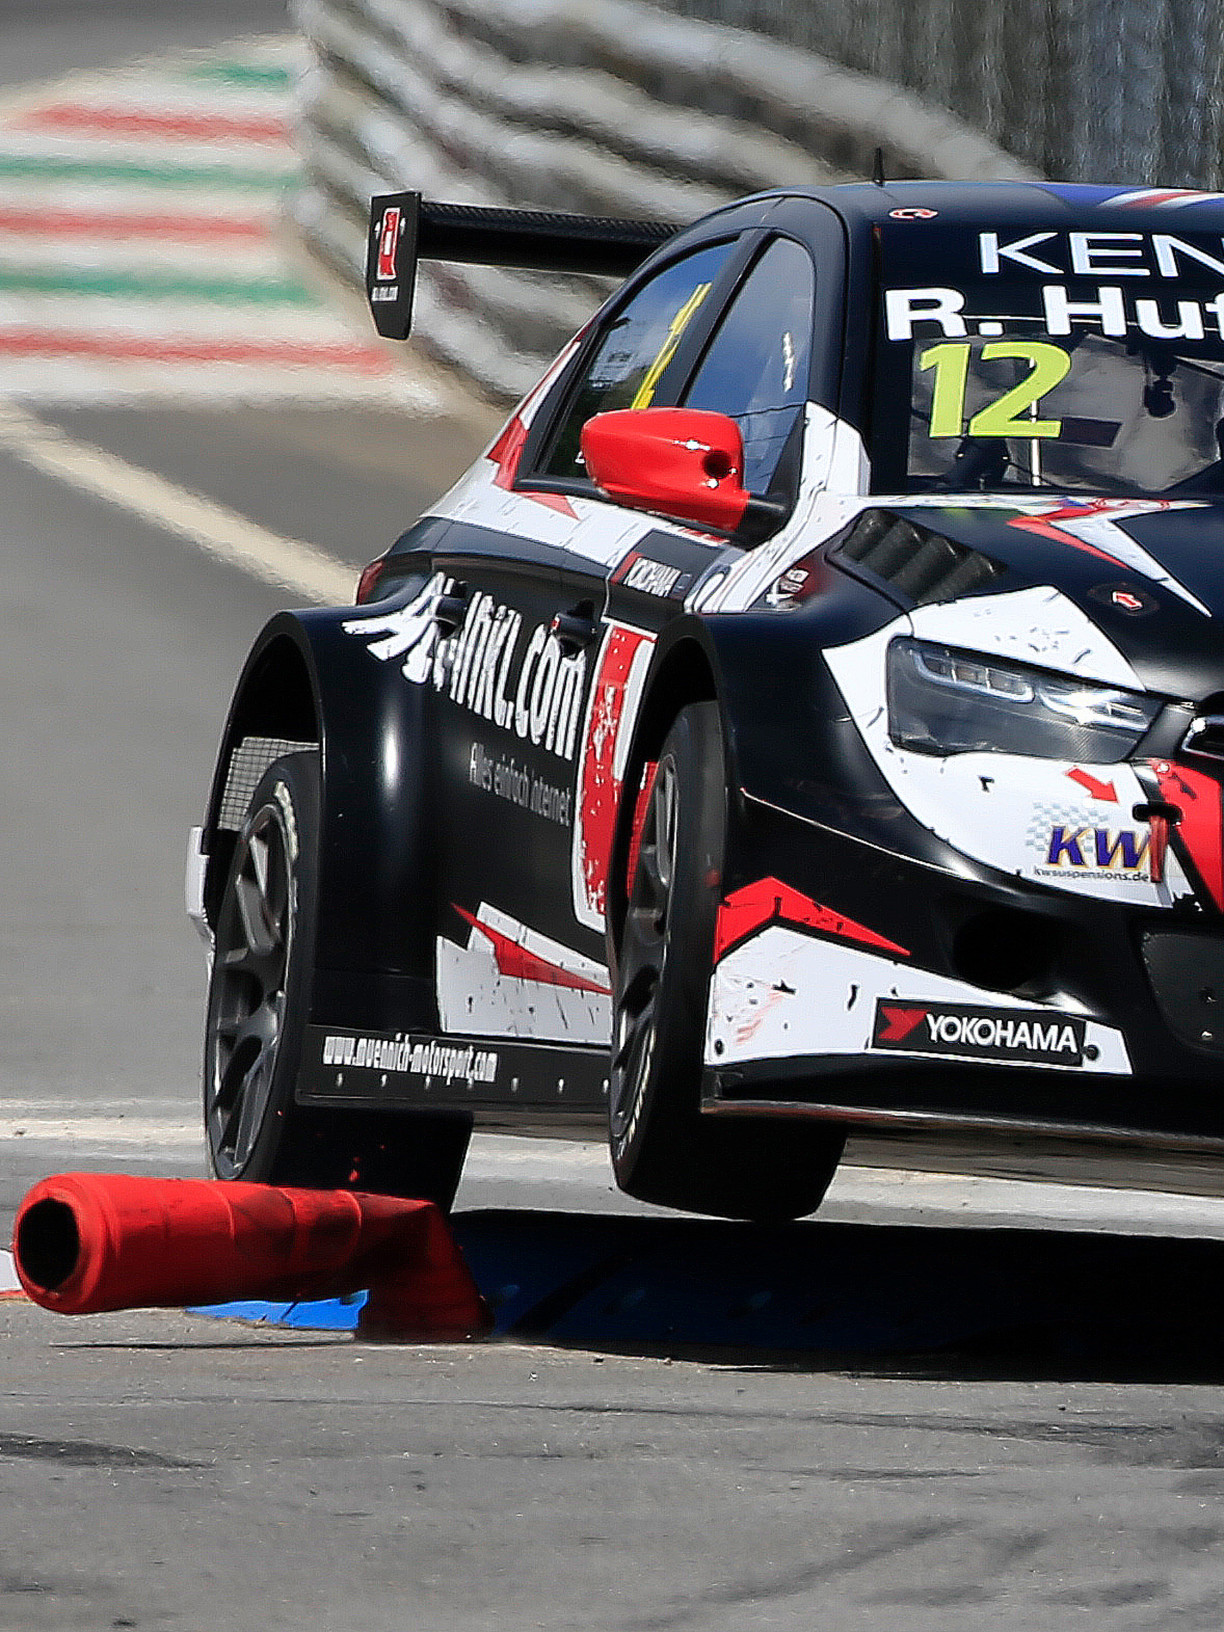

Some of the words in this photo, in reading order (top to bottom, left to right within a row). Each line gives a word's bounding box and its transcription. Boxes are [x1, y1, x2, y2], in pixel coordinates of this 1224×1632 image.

[885, 287, 1004, 341] R.
[919, 341, 1071, 439] 12
[1046, 825, 1151, 871] KW
[1033, 864, 1150, 882] kwsuspensions.de
[926, 1013, 1077, 1054] YOKOHAMA
